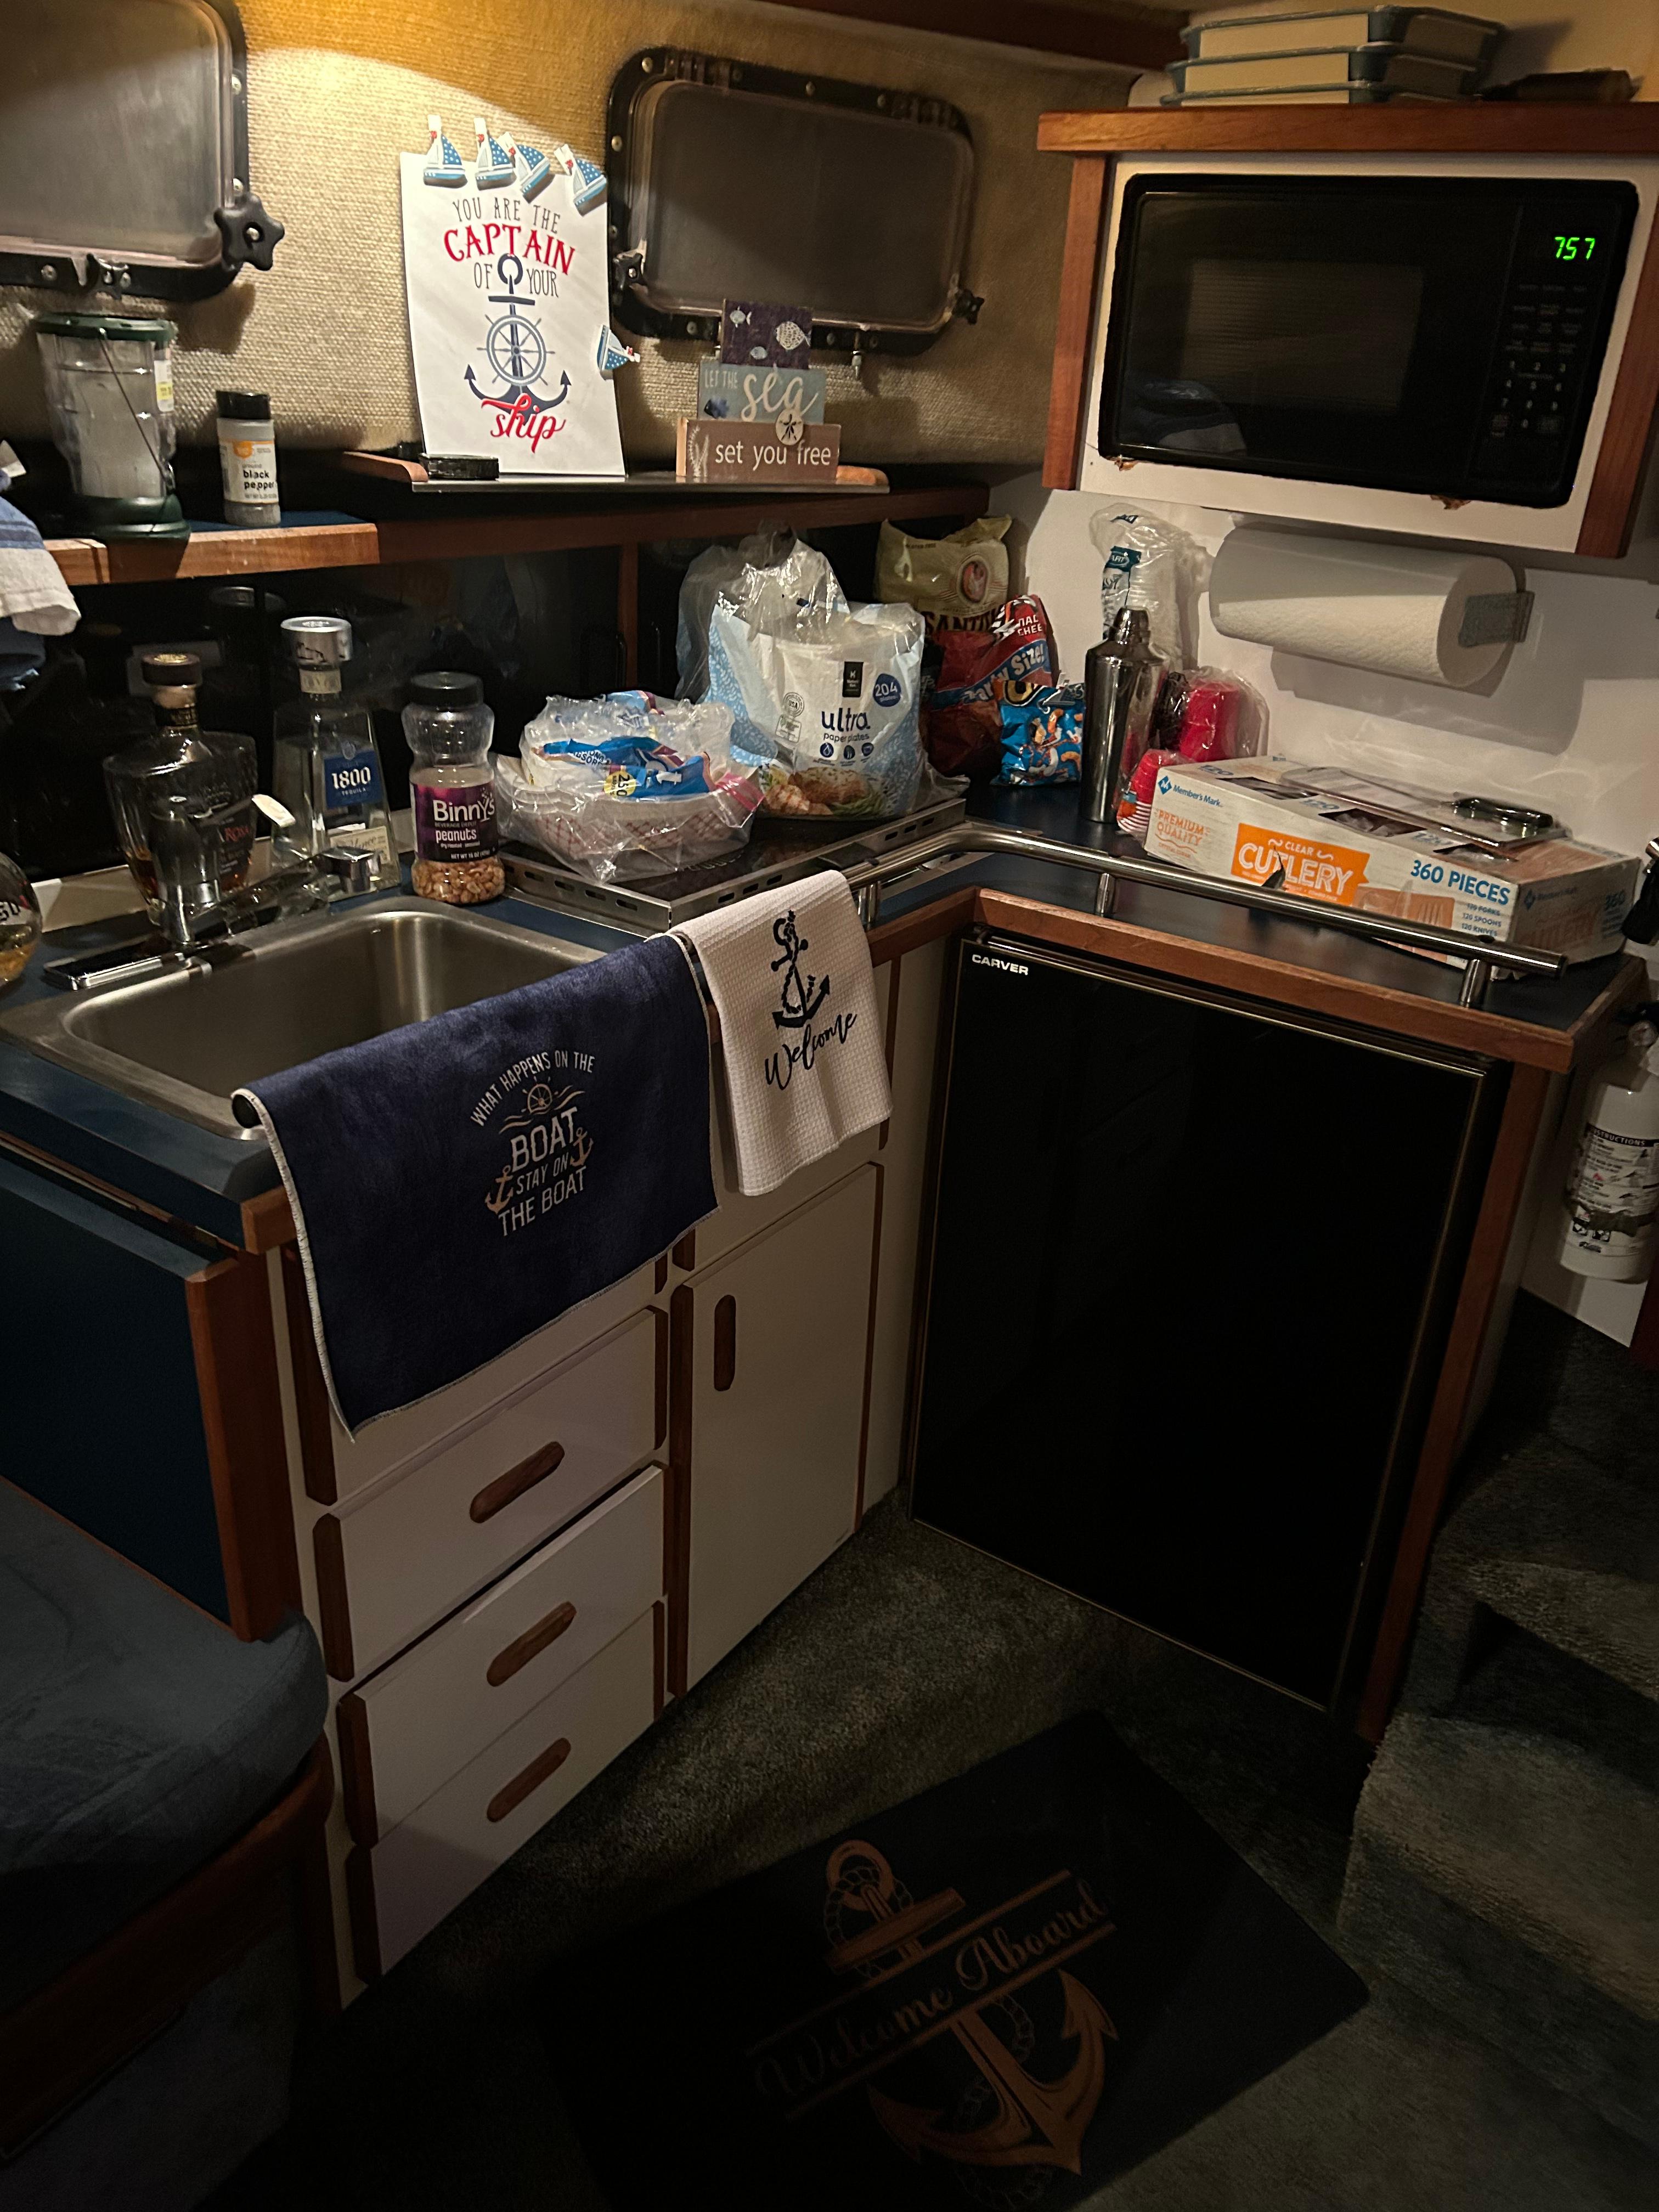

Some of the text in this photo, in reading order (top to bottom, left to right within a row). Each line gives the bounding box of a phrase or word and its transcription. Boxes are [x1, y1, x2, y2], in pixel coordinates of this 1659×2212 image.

[453, 197, 560, 234] YOU ARE THE
[444, 224, 575, 275] CAPTAIN
[474, 262, 558, 297] OF YOUR
[704, 369, 737, 389] LET THE
[741, 373, 819, 421] sea
[481, 392, 566, 454] ship
[715, 440, 831, 471] set you free
[243, 470, 269, 478] black
[244, 482, 274, 490] pepper
[875, 682, 898, 697] 204
[788, 699, 798, 709] USA
[822, 708, 870, 732] ultra
[823, 733, 870, 743] paper plates
[331, 766, 371, 789] 1800
[617, 774, 630, 796] 250
[342, 787, 366, 795] TEQUILA
[1173, 785, 1221, 806] Member's Mark
[1158, 822, 1203, 847] QUALITY
[1159, 810, 1205, 835] PREMIUM
[436, 828, 477, 844] peanuts
[1285, 841, 1315, 856] CLEAR
[1238, 843, 1353, 896] CUTLERY
[1410, 860, 1444, 883] 360
[1448, 870, 1510, 905] PIECES
[1462, 923, 1498, 937] 120 KNIVES
[1474, 916, 1502, 927] SPOONS
[972, 954, 1029, 976] CARVER
[765, 1014, 857, 1091] Welcome
[470, 1049, 596, 1127] WHAT HAPPENS ON THE
[510, 1107, 578, 1172] BOAT
[1592, 1128, 1646, 1147] STRUCTIONS
[516, 1152, 569, 1194] STAY ON
[498, 1166, 587, 1237] THE BOAT
[755, 1878, 1109, 2098] Welcome Aboard
